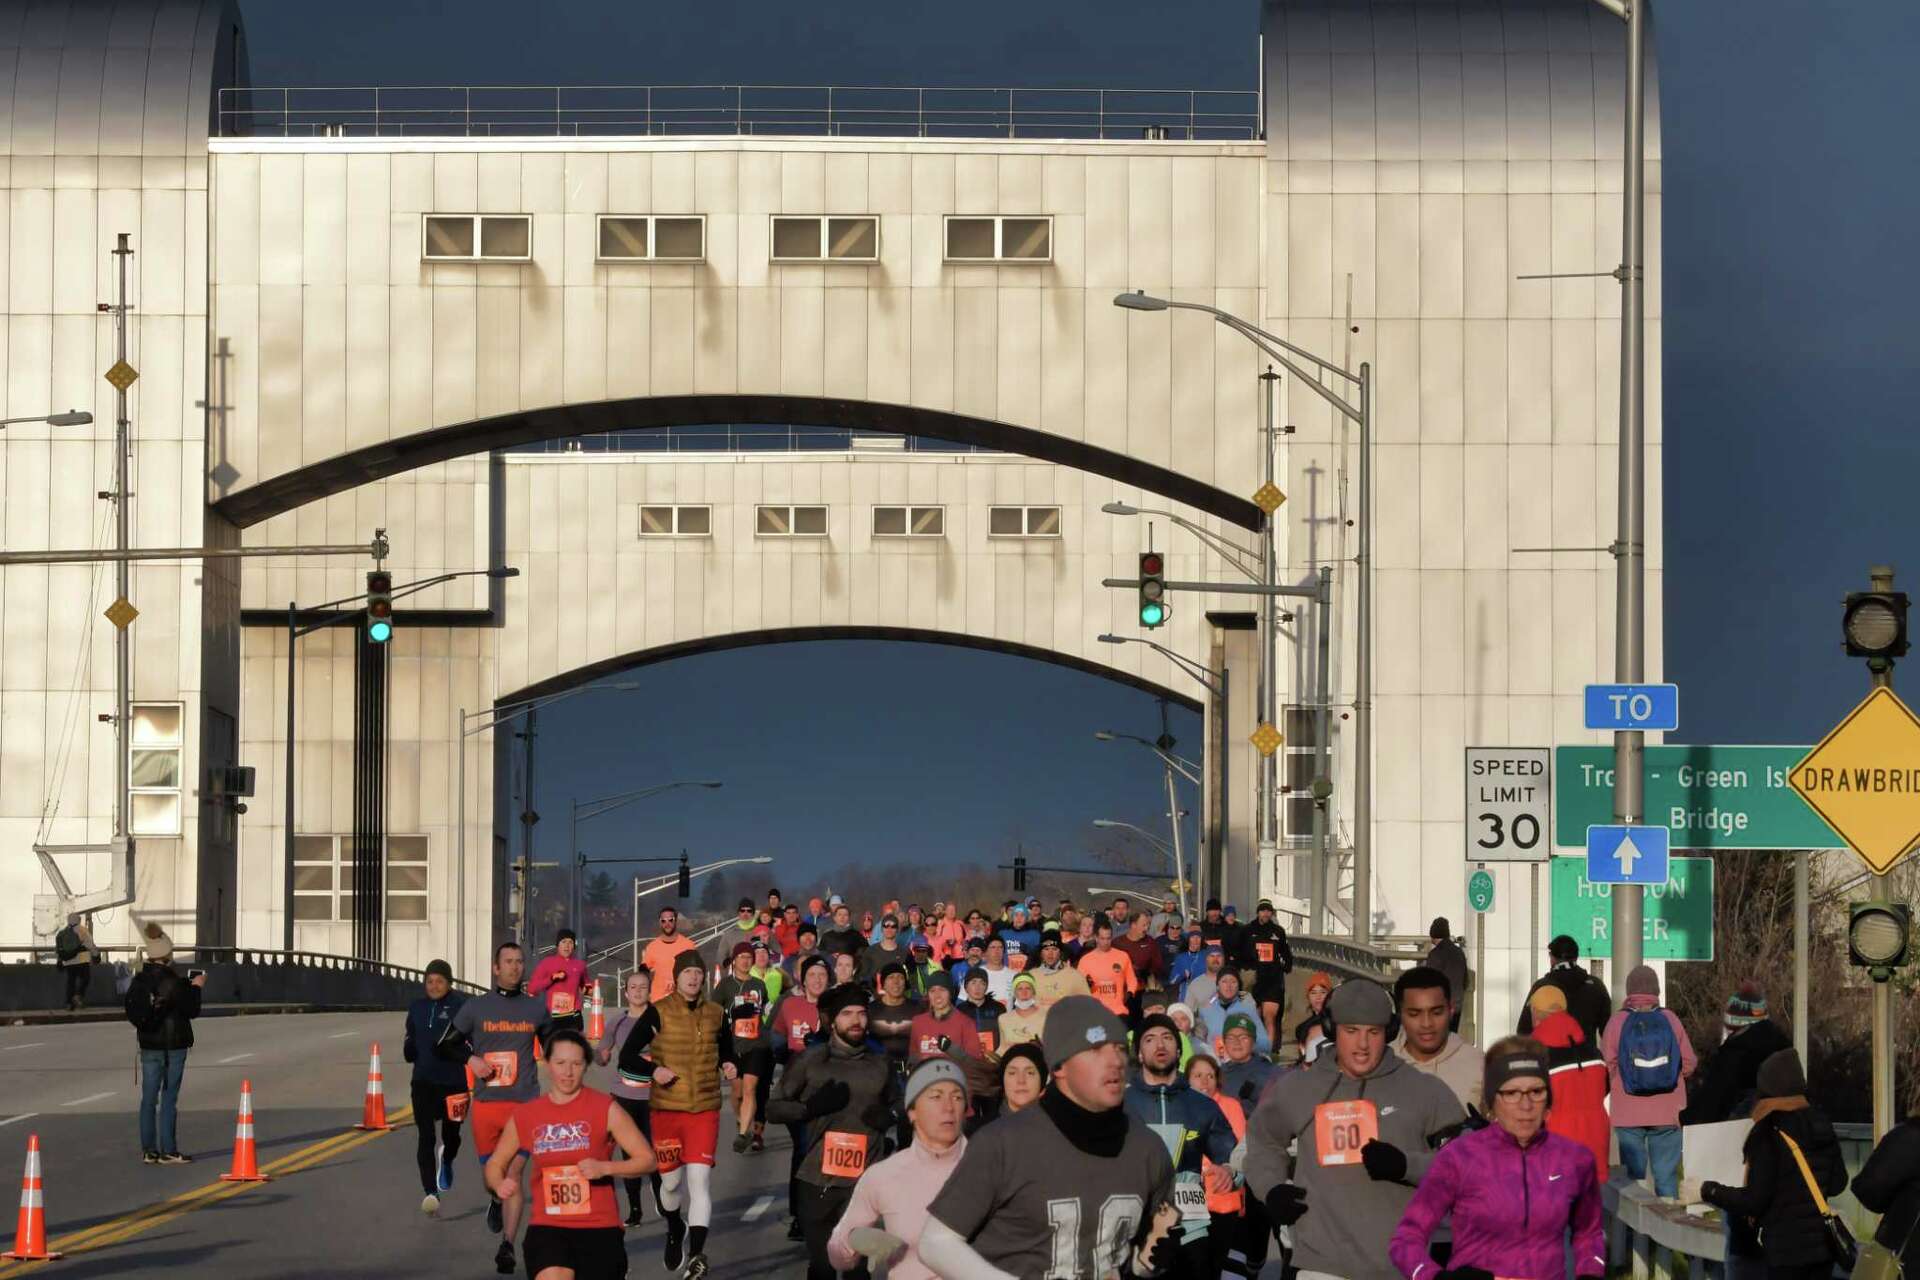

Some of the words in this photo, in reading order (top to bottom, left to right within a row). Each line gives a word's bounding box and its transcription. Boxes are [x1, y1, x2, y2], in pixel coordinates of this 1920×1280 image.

[1608, 694, 1652, 721] TO
[1472, 759, 1544, 776] SPEED
[1580, 764, 1615, 788] Tro
[1678, 765, 1747, 788] Green
[1480, 786, 1536, 803] LIMIT
[1477, 813, 1541, 850] 30
[1670, 806, 1748, 837] Bridge
[1332, 1123, 1361, 1151] 60
[826, 1146, 864, 1170] 1020
[550, 1183, 582, 1206] 589
